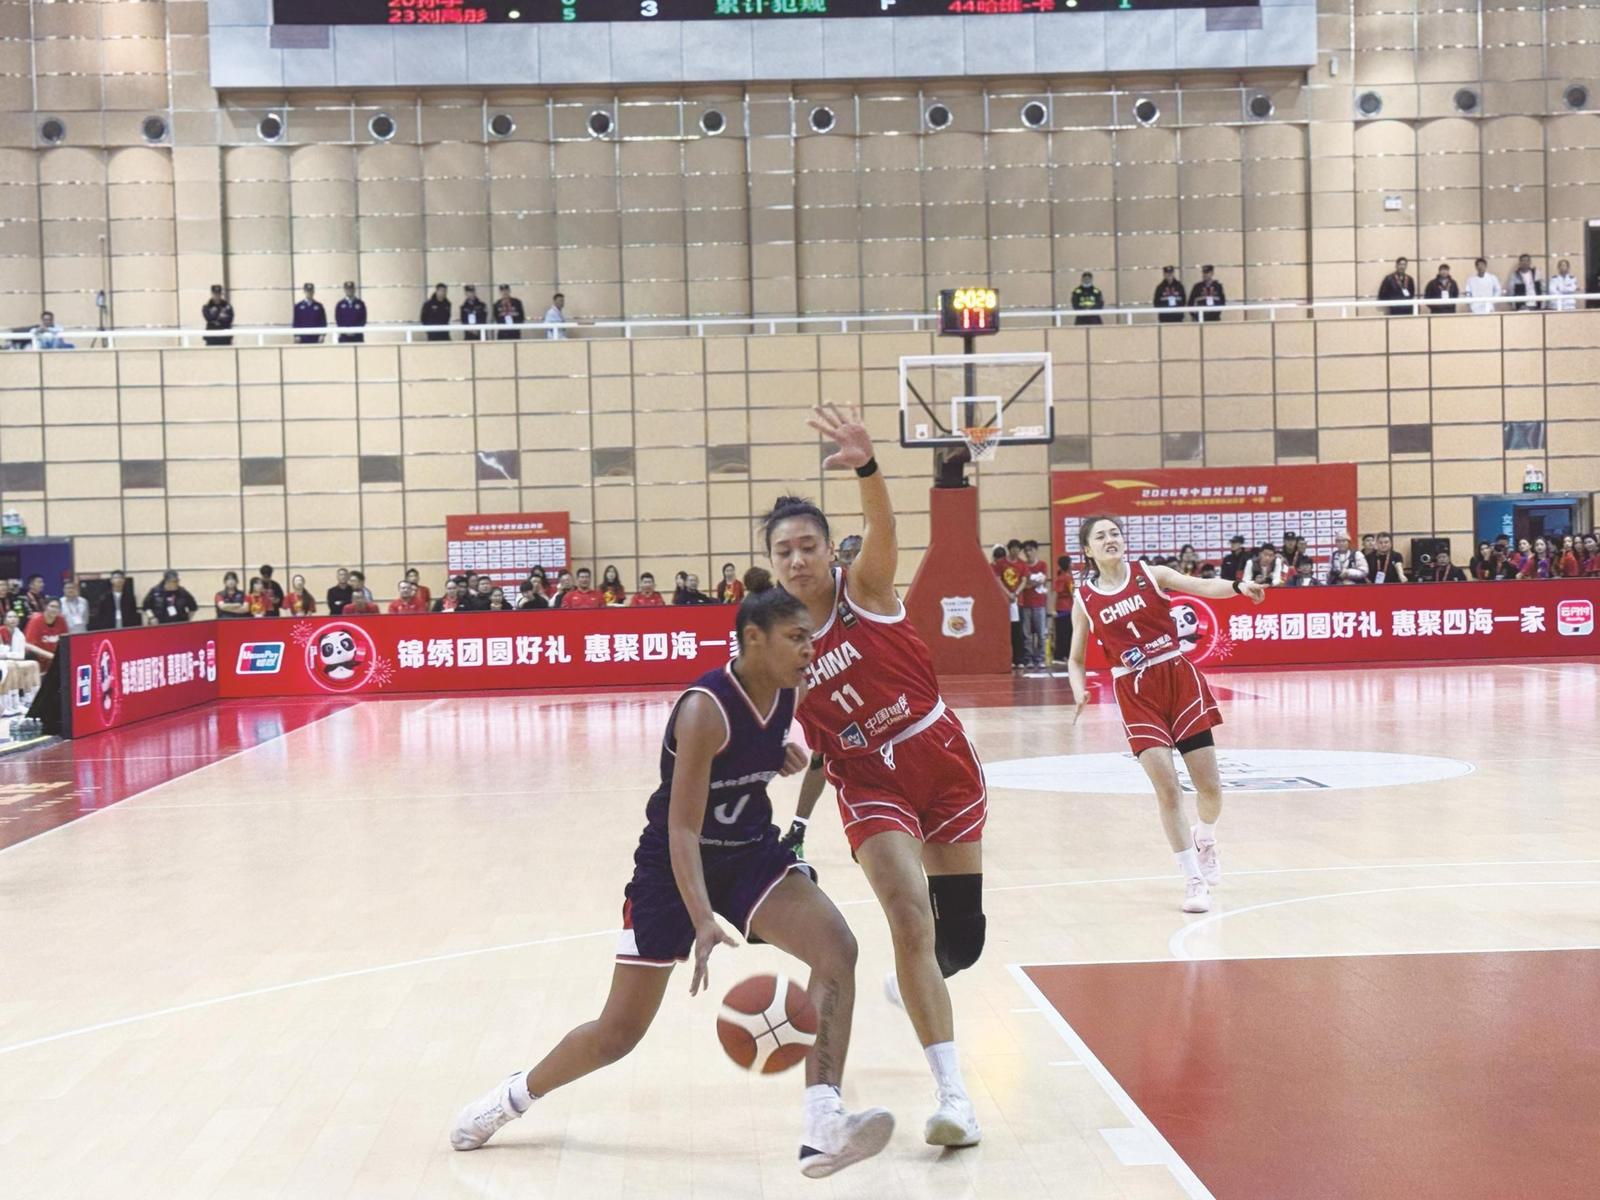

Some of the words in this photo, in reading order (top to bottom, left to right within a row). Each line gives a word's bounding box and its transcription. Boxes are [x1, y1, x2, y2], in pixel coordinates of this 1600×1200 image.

[1100, 594, 1147, 624] CHINA
[1229, 611, 1382, 641] 锦绣团圆好礼
[1392, 605, 1546, 636] 惠聚四海一家
[1126, 621, 1142, 639] 1
[397, 635, 571, 668] 锦绣团圆好礼
[831, 683, 865, 714] 11
